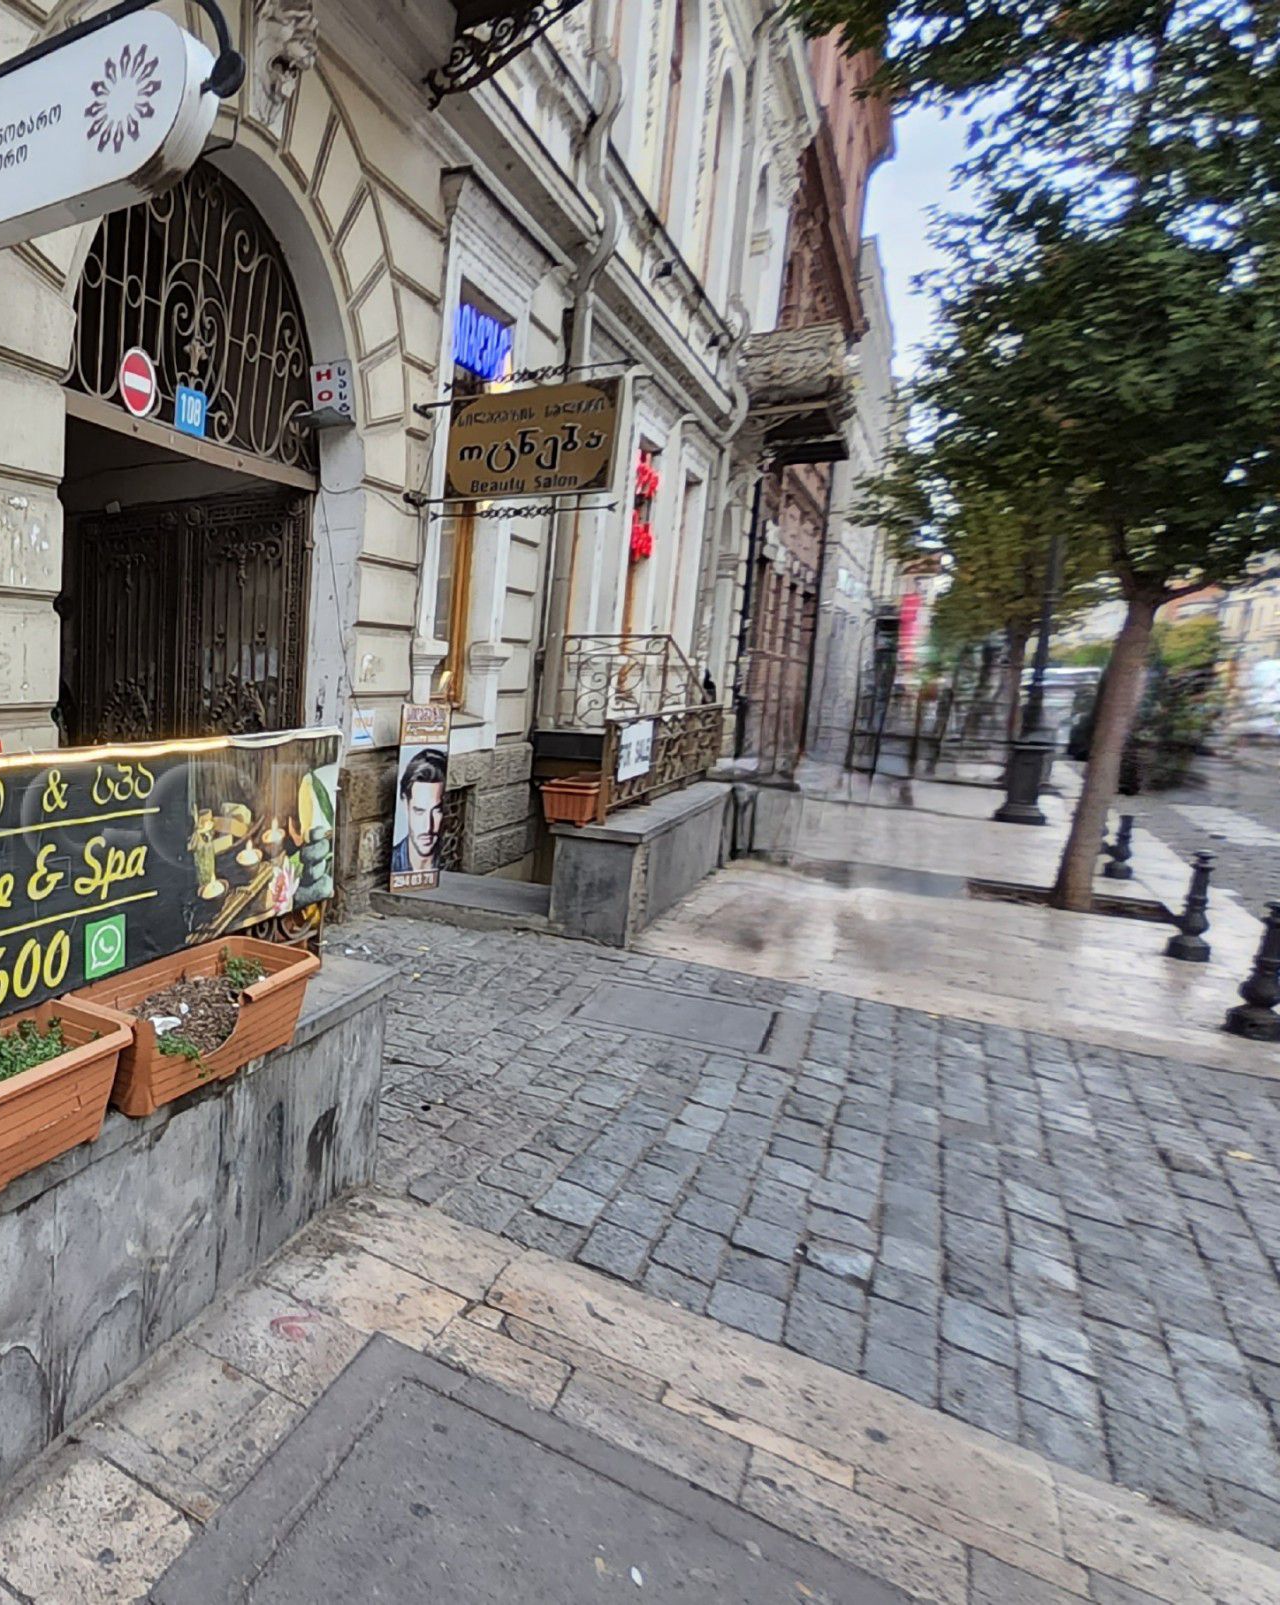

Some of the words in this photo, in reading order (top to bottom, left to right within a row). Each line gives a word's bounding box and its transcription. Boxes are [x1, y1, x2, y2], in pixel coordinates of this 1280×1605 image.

[179, 392, 202, 427] 108
[470, 477, 526, 495] Beauty
[534, 474, 578, 490] Salon
[42, 768, 69, 813] &
[92, 762, 156, 807] სპა
[26, 845, 64, 901] &
[73, 836, 147, 899] Spa
